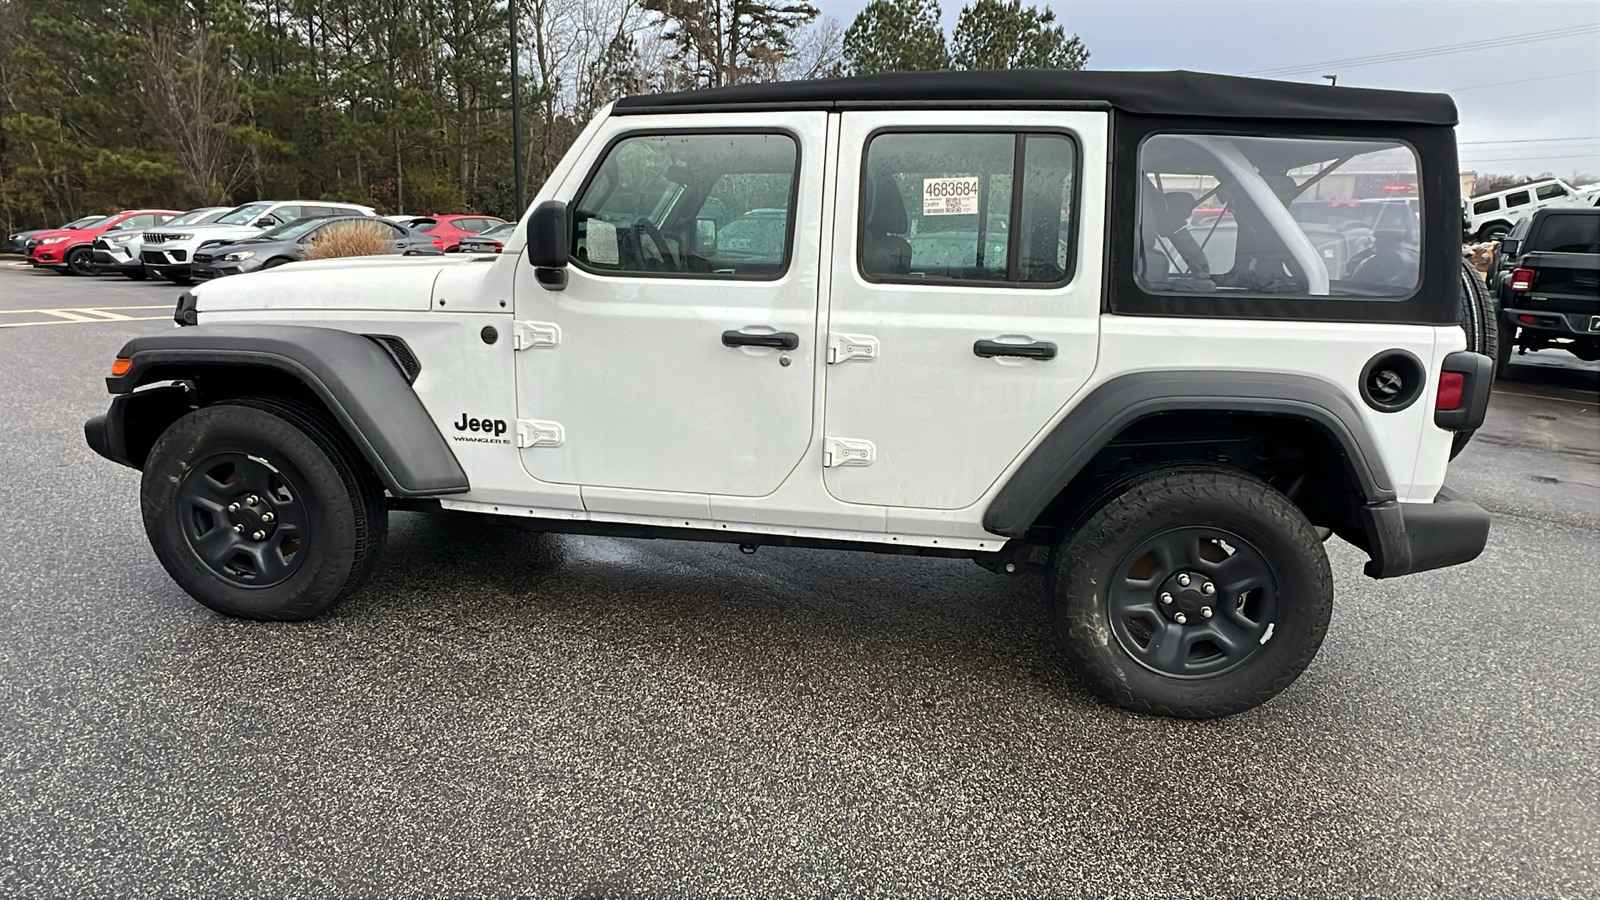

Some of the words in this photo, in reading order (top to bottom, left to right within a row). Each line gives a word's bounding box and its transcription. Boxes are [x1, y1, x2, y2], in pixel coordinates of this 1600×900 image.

[925, 181, 978, 197] 4683684
[454, 412, 507, 437] Jeep
[453, 436, 502, 444] WRANGLER
